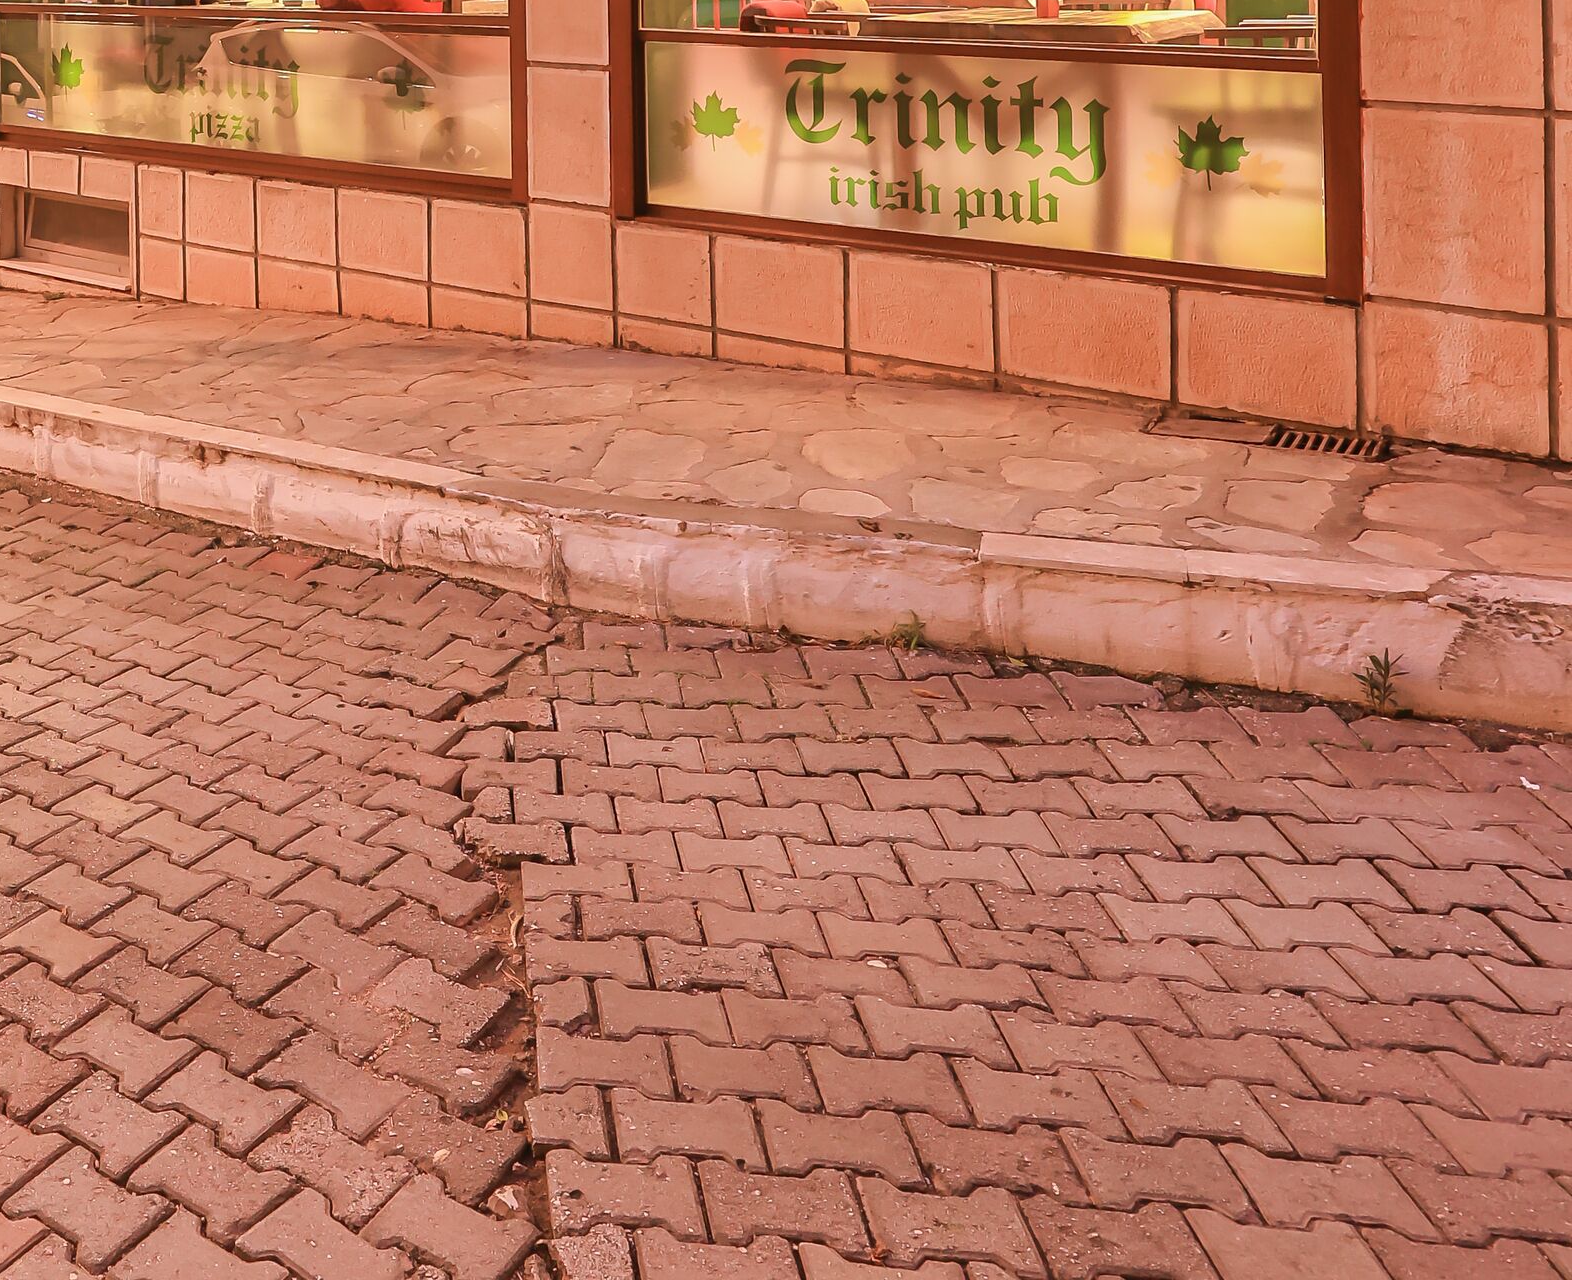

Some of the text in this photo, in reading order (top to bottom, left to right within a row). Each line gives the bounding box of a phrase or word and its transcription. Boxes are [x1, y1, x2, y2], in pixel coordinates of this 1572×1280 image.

[143, 34, 301, 120] Trinity
[189, 105, 261, 143] pizza
[785, 58, 1111, 186] Trinity
[828, 166, 1059, 231] irish pub
